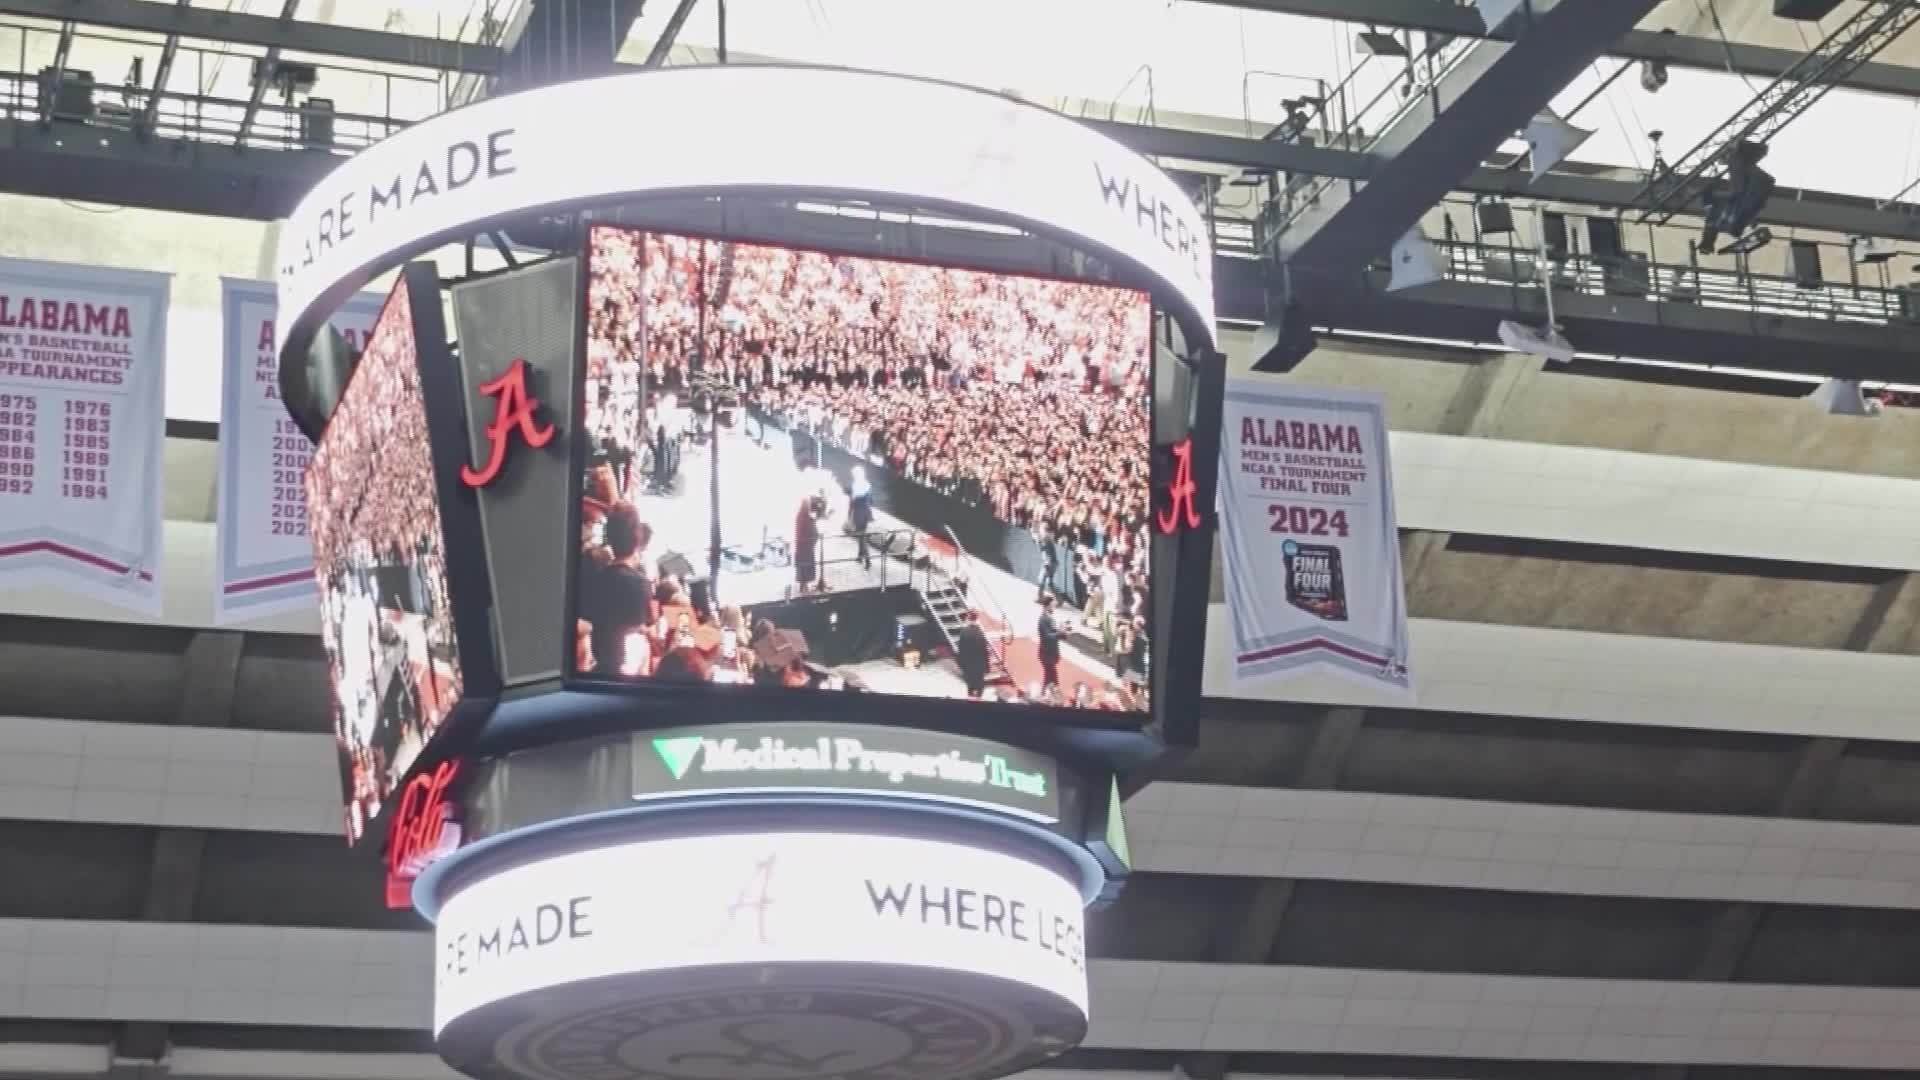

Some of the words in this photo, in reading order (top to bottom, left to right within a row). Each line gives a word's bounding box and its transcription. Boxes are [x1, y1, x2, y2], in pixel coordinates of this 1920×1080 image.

[369, 128, 517, 224] MADE
[0, 295, 132, 338] LABAMA
[28, 334, 132, 355] BASKETBALL
[22, 348, 134, 370] TOURNAMENT
[0, 360, 123, 385] PPEARANCES
[0, 393, 37, 411] 975
[63, 399, 112, 417] 1976
[0, 410, 36, 428] 982
[63, 416, 111, 434] 1983
[459, 357, 555, 488] A
[0, 428, 34, 444] 984
[63, 432, 110, 450] 1985
[272, 436, 312, 452] 200
[1241, 415, 1363, 455] ALABAMA
[0, 444, 34, 460] 986
[62, 450, 110, 466] 1989
[272, 452, 308, 468] 200
[1284, 452, 1367, 470] BASKETBALL
[0, 461, 34, 477] 990
[62, 466, 106, 483] 1991
[1241, 462, 1276, 475] NCAA
[1279, 465, 1367, 482] TOURNAMENT
[0, 478, 33, 494] 992
[61, 483, 108, 499] 1994
[1156, 437, 1200, 535] A
[1260, 476, 1308, 492] FINAL
[1312, 480, 1351, 496] FOUR
[271, 504, 306, 520] 202
[1267, 504, 1349, 538] 2024
[271, 520, 308, 537] 202
[1292, 556, 1331, 574] FINAL
[1293, 572, 1331, 590] FOUR
[701, 736, 833, 772] Medical
[833, 737, 987, 783] Properties
[984, 753, 1047, 798] Trust
[865, 878, 1029, 942] WHERE
[478, 895, 594, 962] MADE
